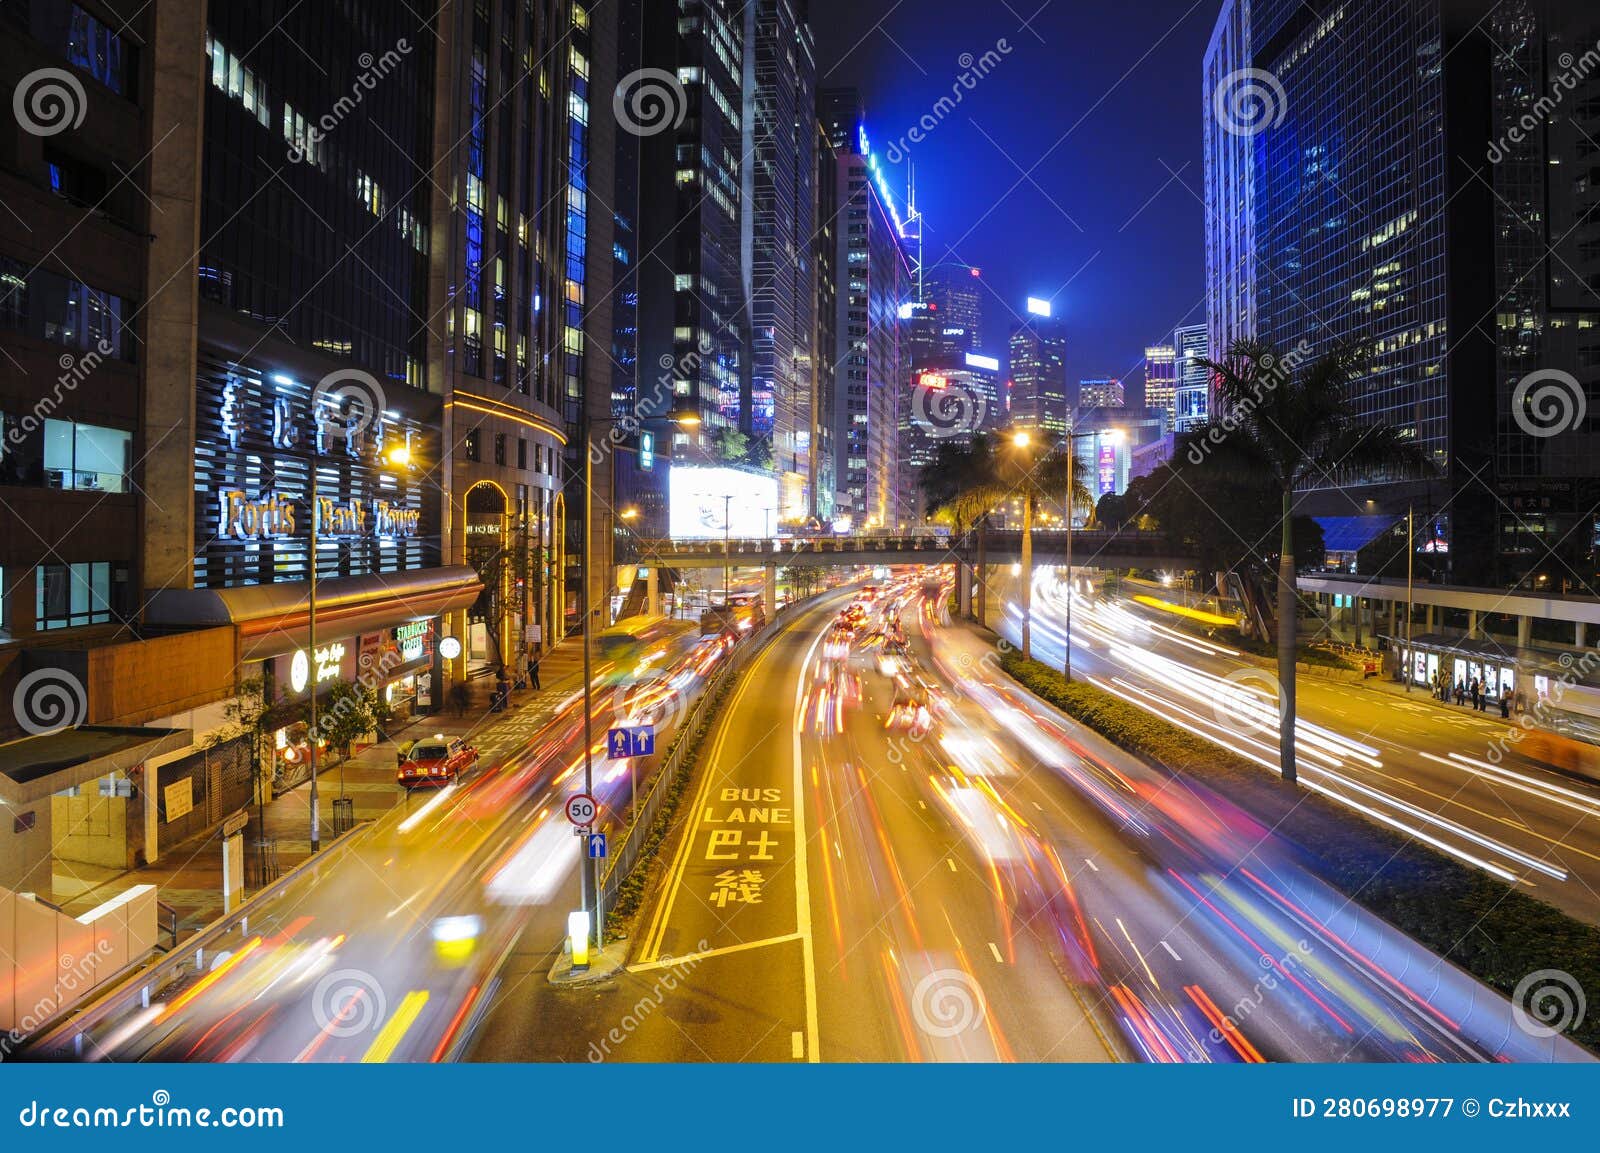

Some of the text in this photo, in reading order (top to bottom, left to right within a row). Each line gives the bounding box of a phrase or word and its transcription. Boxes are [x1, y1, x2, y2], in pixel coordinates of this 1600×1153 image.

[219, 486, 296, 538] Fortis
[316, 494, 367, 537] Bank
[397, 620, 428, 640] STARBUCKS
[403, 635, 423, 651] COFFEE
[720, 788, 781, 802] BUS
[572, 804, 592, 816] 50
[704, 807, 791, 824] LANE
[705, 829, 778, 860] 巴士
